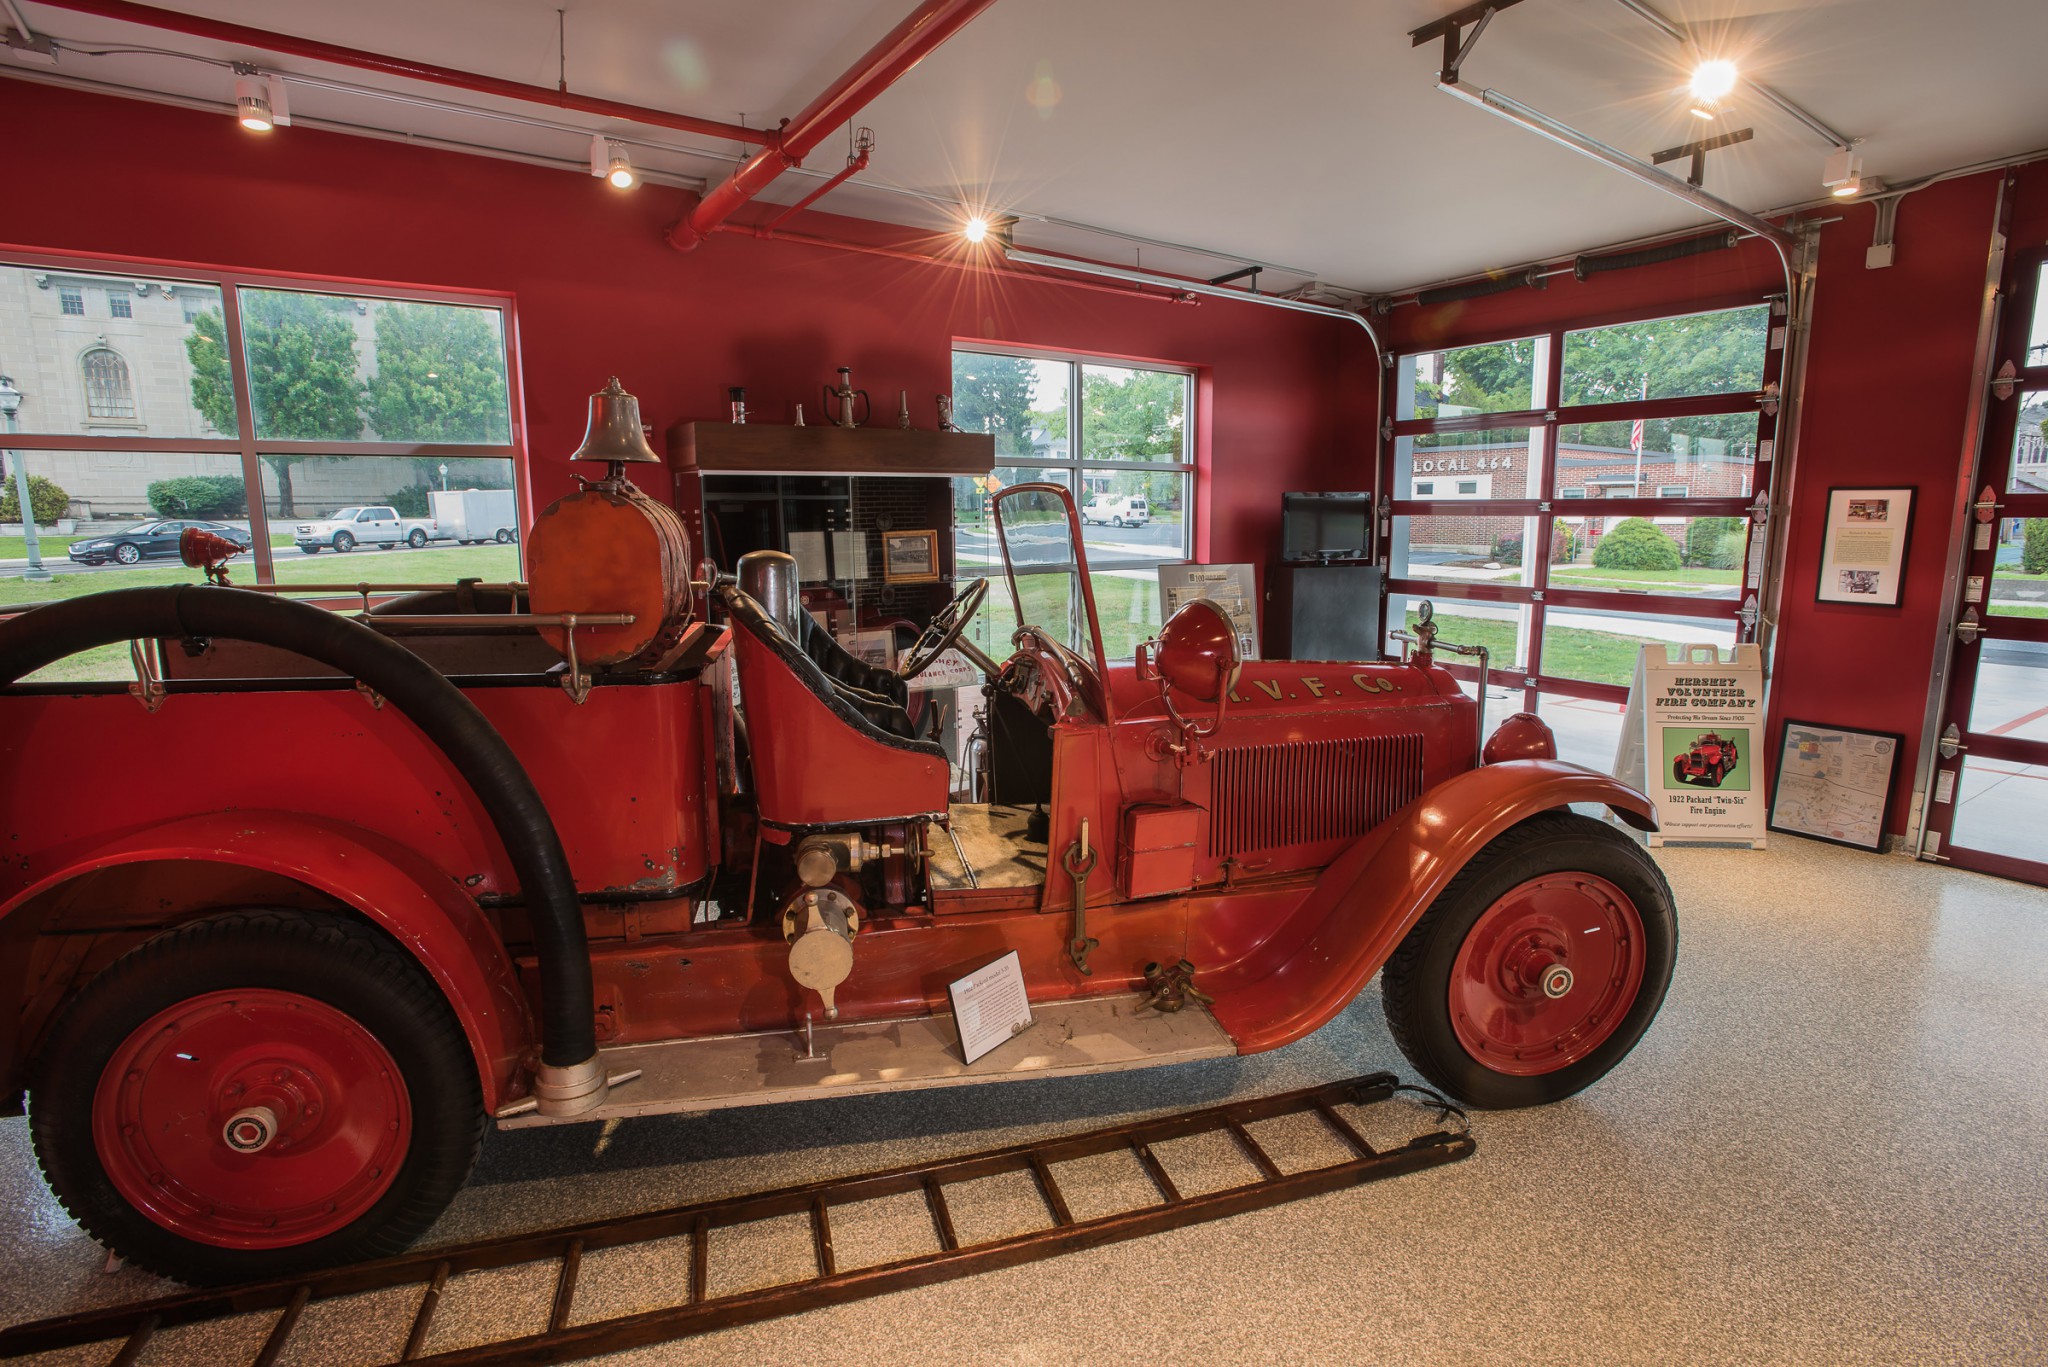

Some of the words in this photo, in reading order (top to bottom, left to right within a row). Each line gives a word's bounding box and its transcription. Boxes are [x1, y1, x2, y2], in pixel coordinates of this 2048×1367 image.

[1413, 458, 1469, 473] LOCAL
[1477, 456, 1513, 470] 464
[1674, 677, 1737, 687] HERSHEY
[1667, 687, 1745, 697] VOLUNTEER
[1656, 698, 1688, 706] FIRE
[1691, 698, 1756, 708] COMPANY
[1668, 795, 1685, 803] 1922
[1686, 795, 1712, 804] Packard
[1690, 806, 1703, 814] Fire
[1704, 806, 1726, 816] Engine
